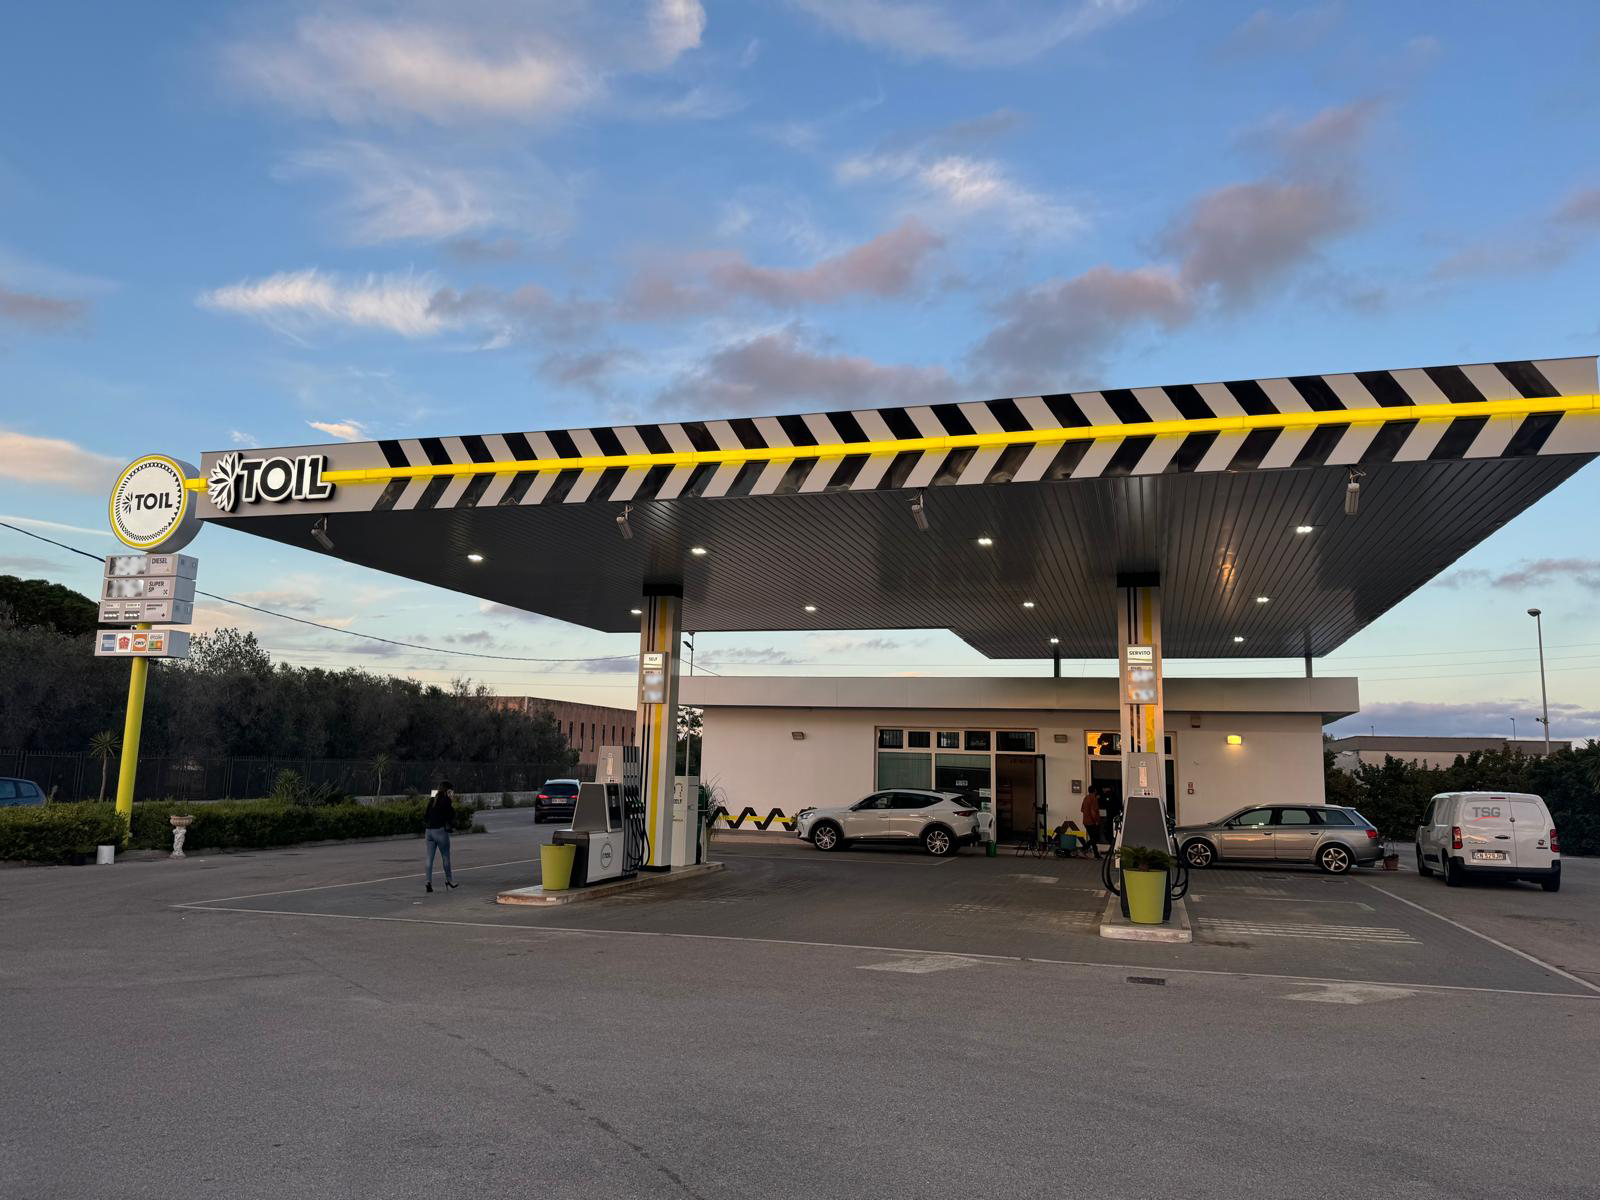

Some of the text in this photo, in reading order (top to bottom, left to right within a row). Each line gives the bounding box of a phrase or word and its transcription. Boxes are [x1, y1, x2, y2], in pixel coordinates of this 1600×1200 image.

[239, 455, 333, 502] TOIL
[134, 491, 173, 511] TOIL
[1472, 806, 1501, 818] TSG
